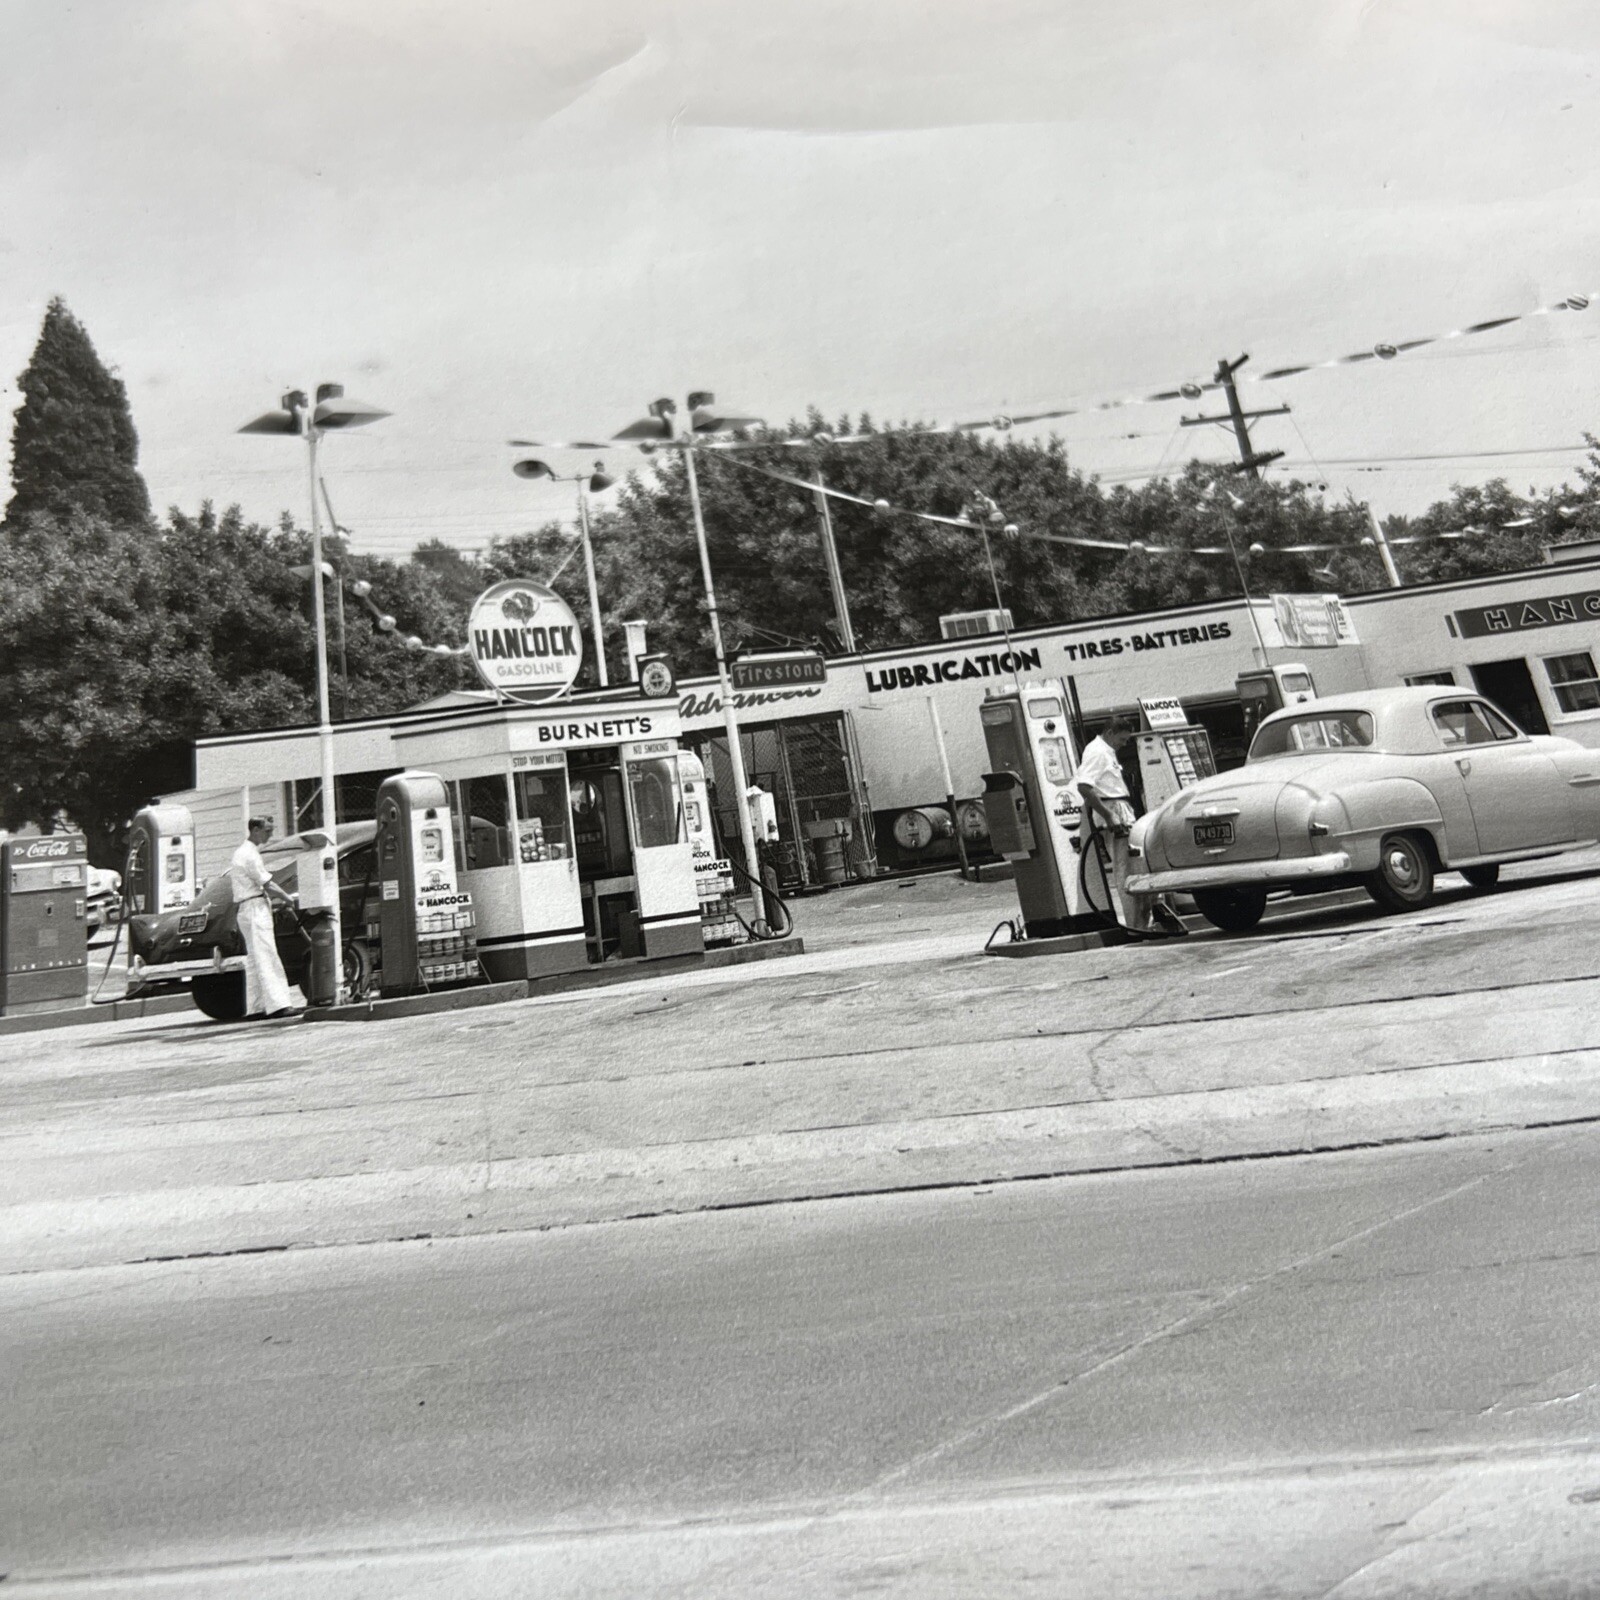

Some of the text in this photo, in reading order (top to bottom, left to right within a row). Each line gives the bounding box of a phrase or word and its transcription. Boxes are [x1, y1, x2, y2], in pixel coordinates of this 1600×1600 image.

[474, 625, 577, 660] HANCOCK
[496, 661, 563, 677] GASOLINE
[734, 662, 822, 685] Firestone
[865, 648, 1041, 693] LUBRICATION
[1143, 700, 1180, 711] HANCOCK
[538, 716, 652, 742] BURNETT'S
[643, 742, 669, 754] SMOKING
[512, 756, 528, 767] STOP
[530, 754, 544, 766] YOUR
[1053, 806, 1082, 816] HANCOCK
[26, 840, 71, 858] Coca-Cola
[420, 883, 451, 893] HANCOCK
[426, 894, 469, 908] HANCOCK
